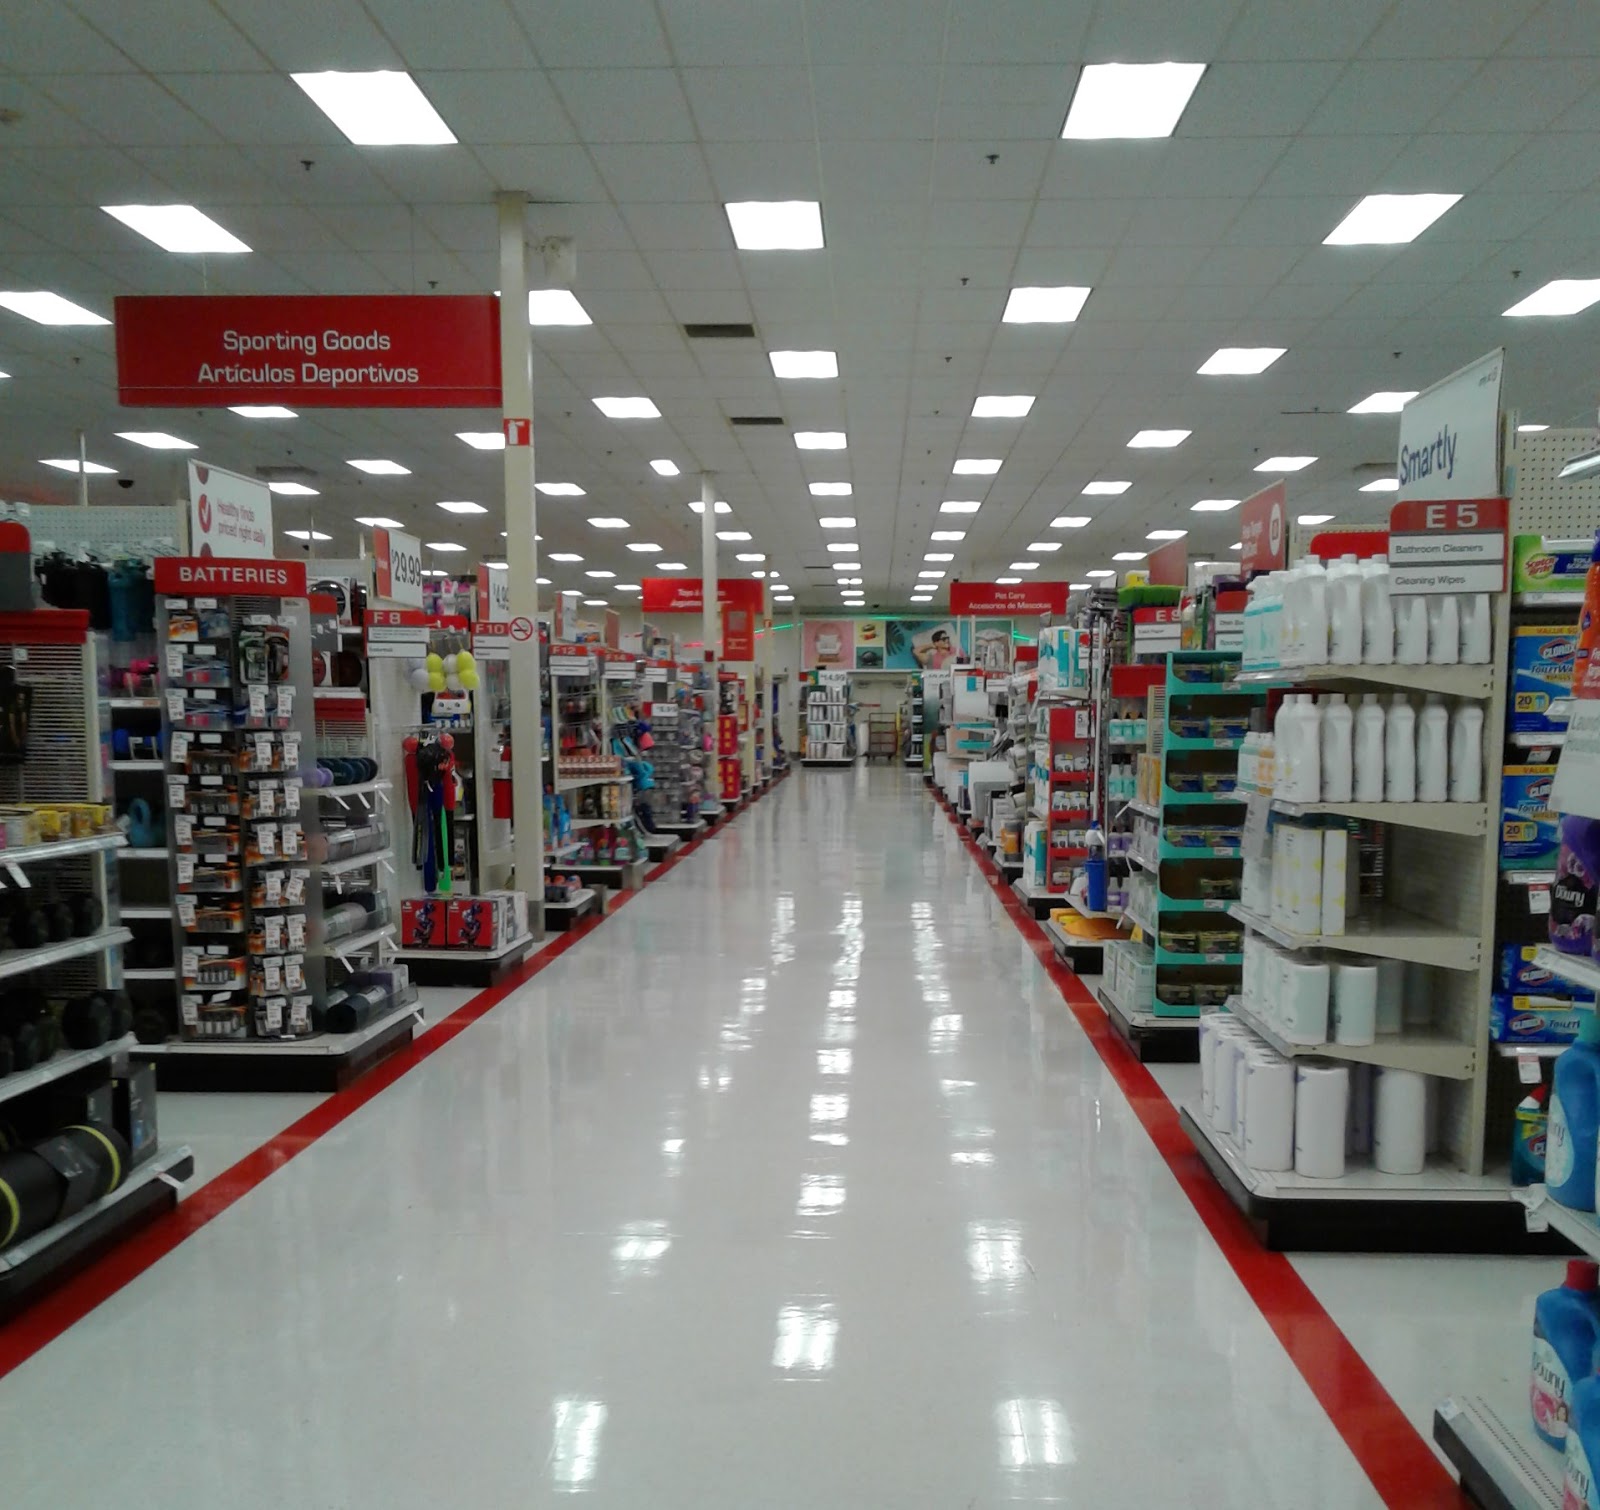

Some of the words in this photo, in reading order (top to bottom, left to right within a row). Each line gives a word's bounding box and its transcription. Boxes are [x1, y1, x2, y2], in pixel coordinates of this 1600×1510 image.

[223, 330, 317, 355] Sporting
[323, 330, 391, 350] Goods
[198, 362, 295, 383] Artículos
[302, 363, 419, 388] Deportivos
[1400, 424, 1457, 486] Smartly
[1426, 505, 1446, 529] E
[1457, 504, 1478, 528] 5
[1395, 544, 1440, 554] Bathroom
[1442, 544, 1484, 553] Cleaners
[180, 566, 288, 584] BATTERIES
[391, 549, 421, 587] $29.99
[1395, 576, 1436, 586] Cleaning
[1438, 576, 1466, 585] Wipes
[373, 612, 384, 624] F
[389, 612, 402, 625] 8
[1518, 695, 1532, 705] 20
[1555, 884, 1586, 908] Downy
